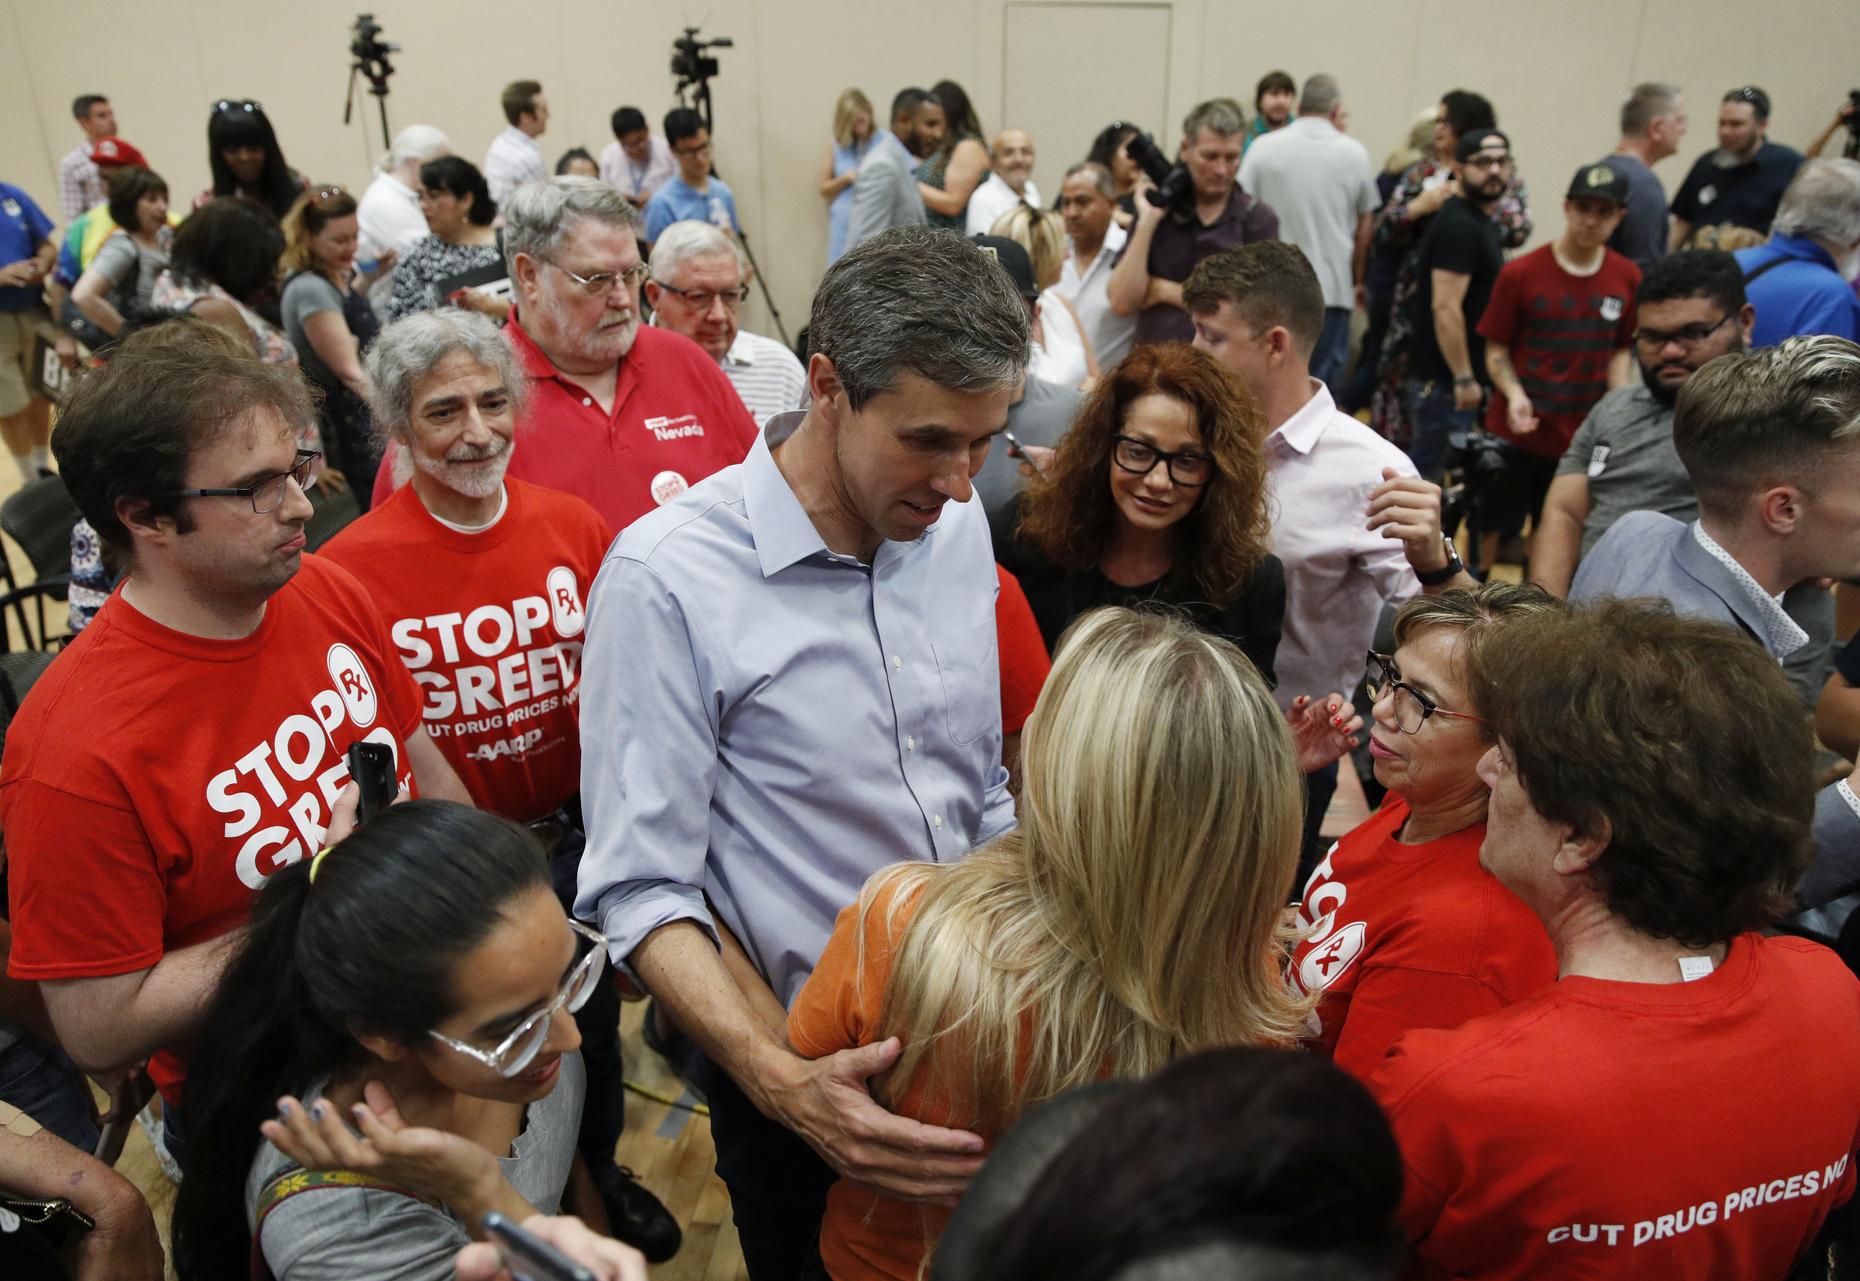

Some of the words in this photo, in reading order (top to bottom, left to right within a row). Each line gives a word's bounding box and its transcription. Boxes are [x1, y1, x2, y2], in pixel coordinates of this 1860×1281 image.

[653, 422, 705, 441] Nevada
[391, 596, 550, 670] STOP
[411, 641, 583, 720] GREED
[426, 722, 452, 738] UT
[455, 715, 504, 736] DRUG
[506, 697, 559, 728] PRICES
[562, 683, 582, 707] NO
[206, 690, 346, 838] STOP
[468, 728, 543, 761] AARP
[1295, 840, 1347, 944] TOP
[1547, 1223, 1625, 1247] CUT
[1633, 1202, 1717, 1247] DRUG
[1723, 1170, 1819, 1220] PRICES
[1822, 1153, 1849, 1190] NO
